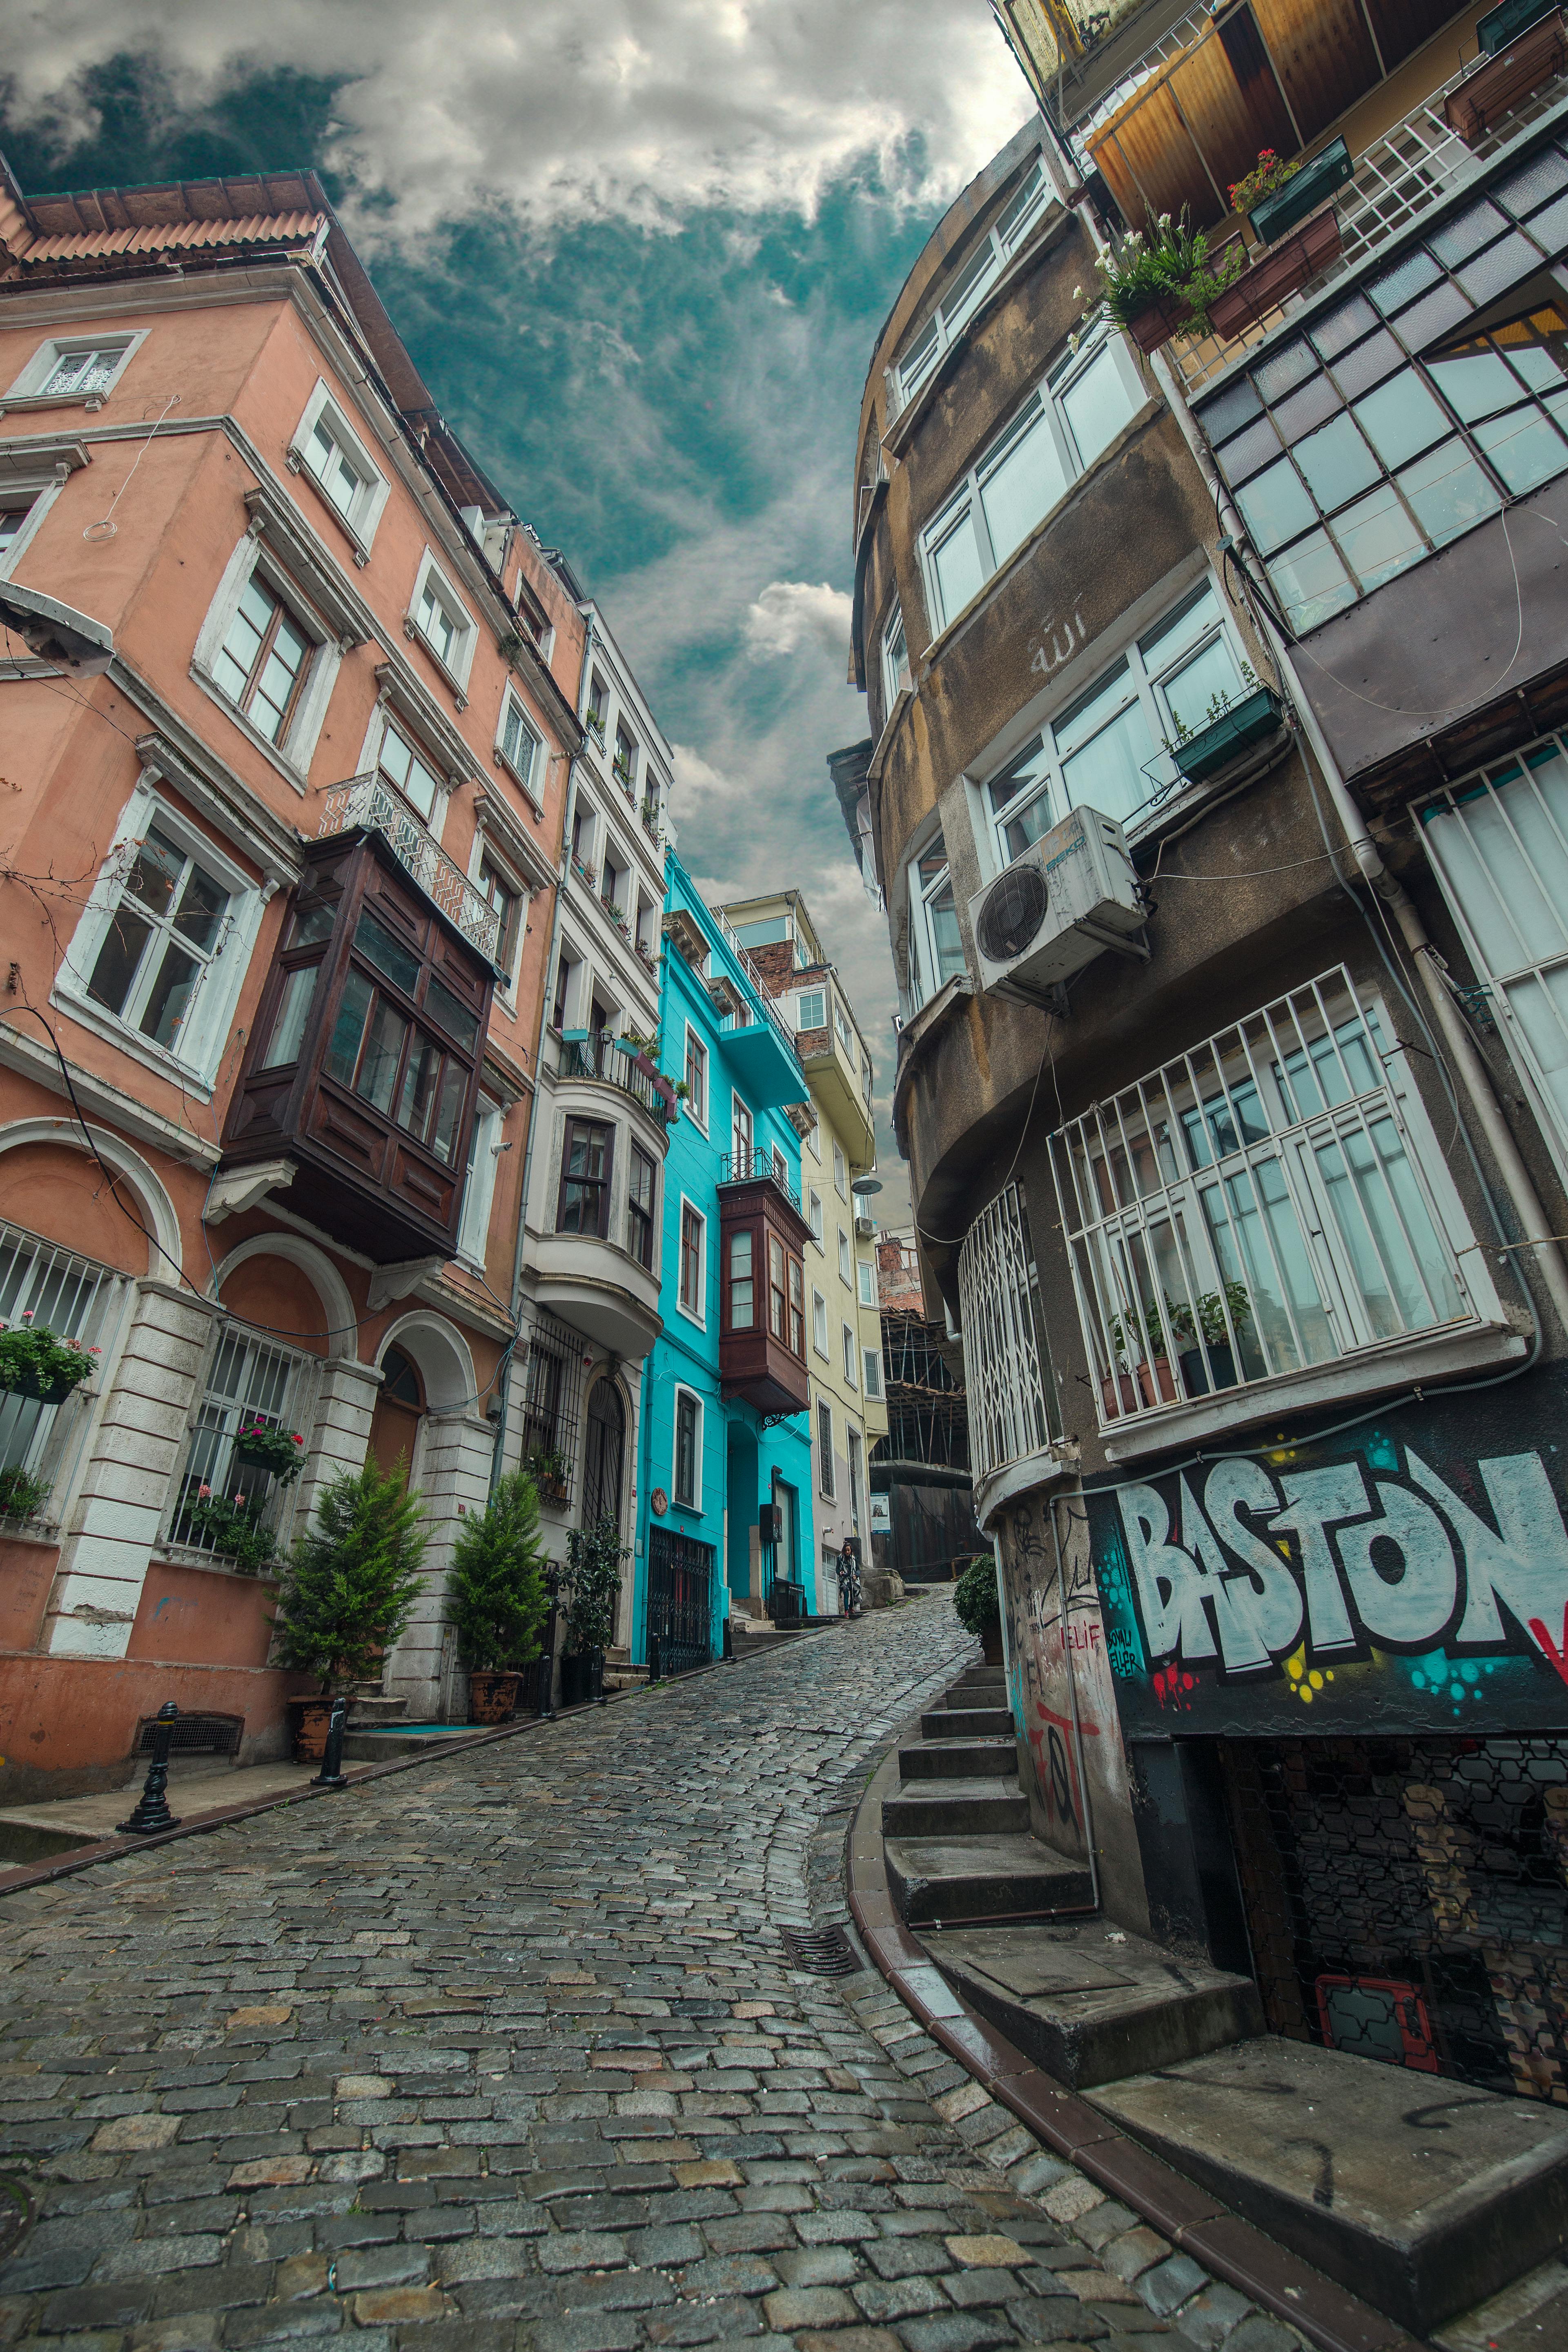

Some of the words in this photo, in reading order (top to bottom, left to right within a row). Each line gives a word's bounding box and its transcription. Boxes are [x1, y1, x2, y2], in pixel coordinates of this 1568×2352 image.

[1046, 836, 1085, 872] BEKO
[1116, 1445, 1568, 1673] BASTON
[1109, 1649, 1145, 1676] ELLER
